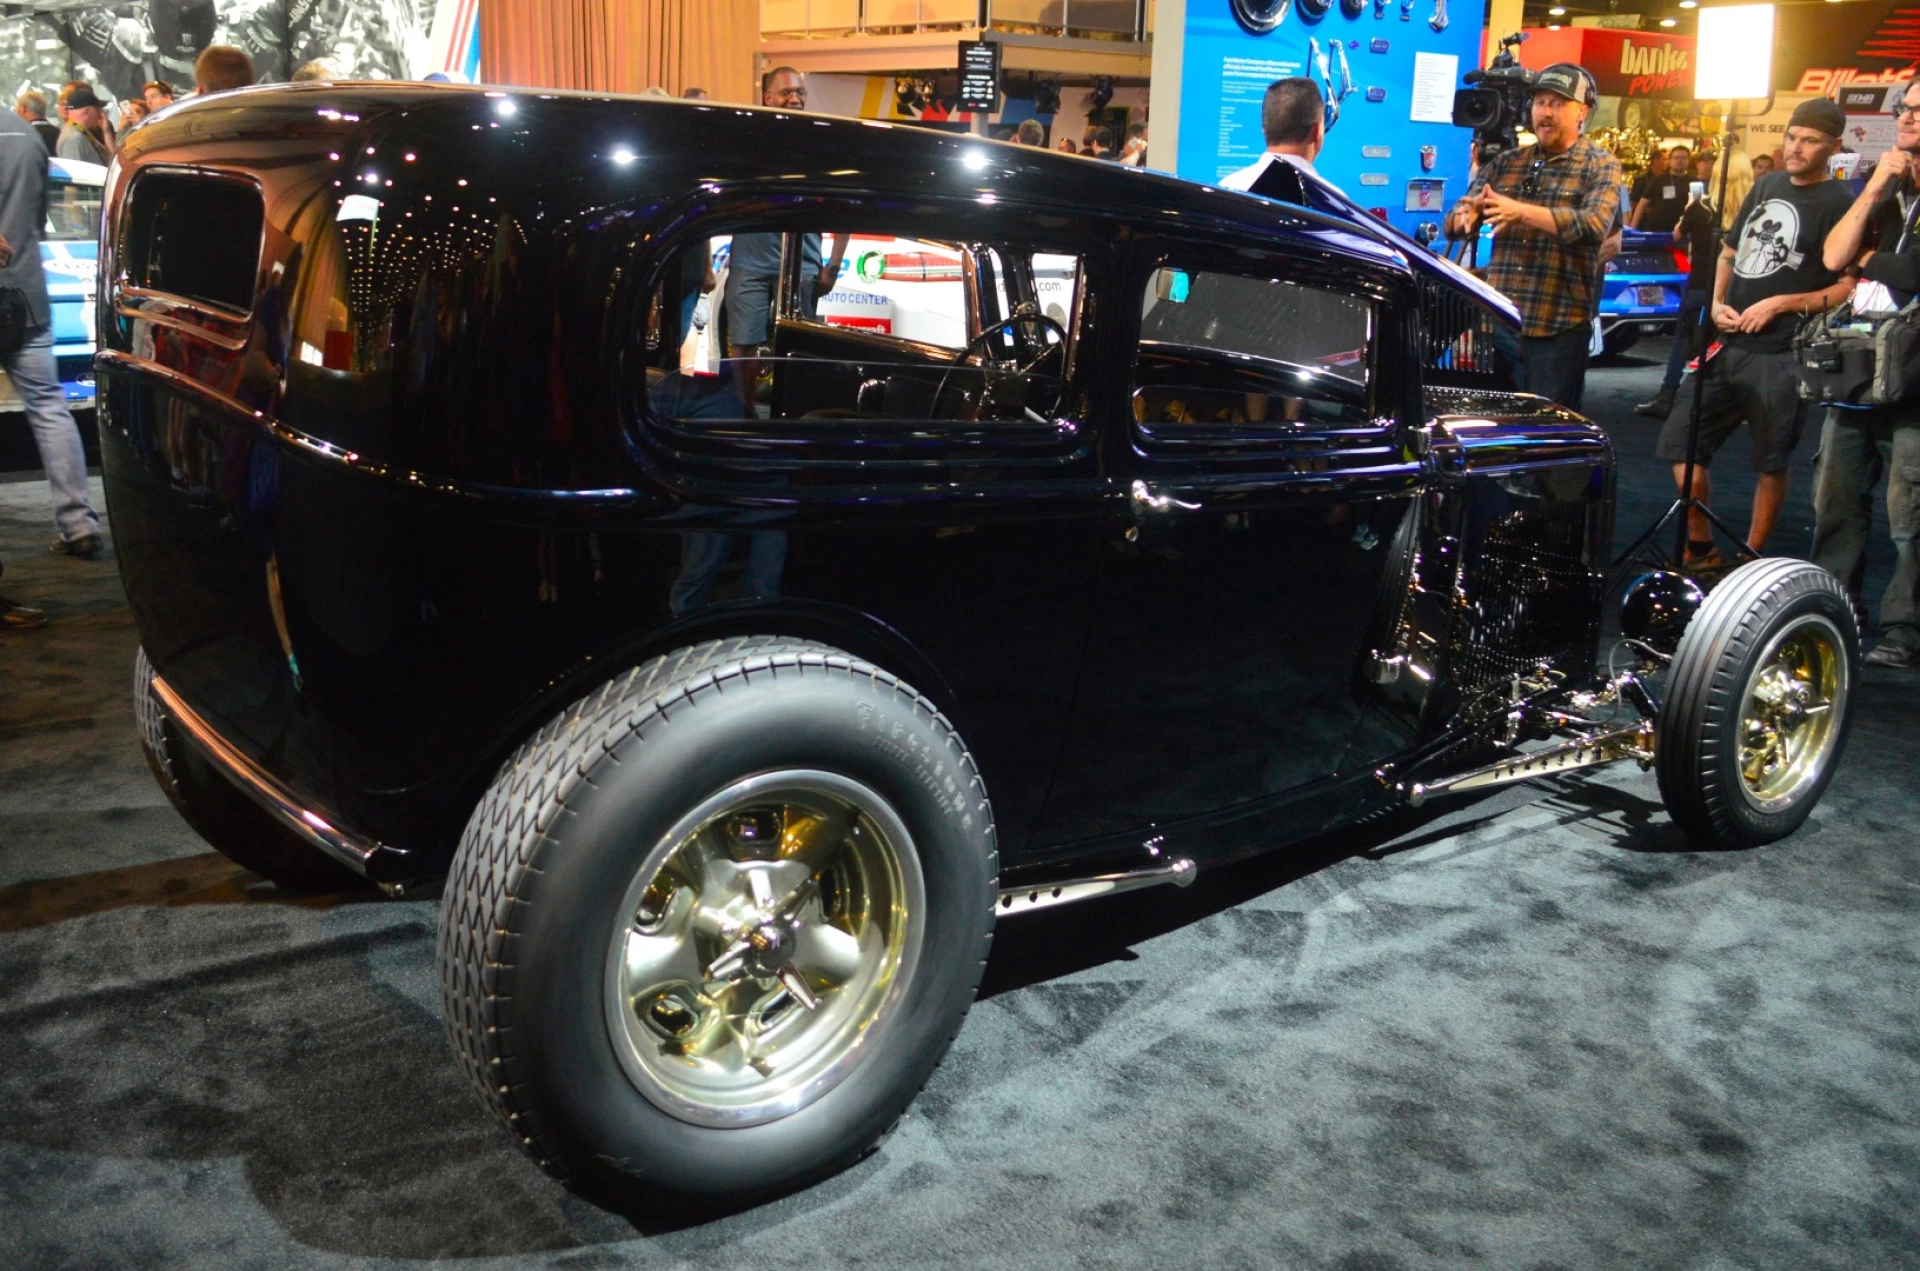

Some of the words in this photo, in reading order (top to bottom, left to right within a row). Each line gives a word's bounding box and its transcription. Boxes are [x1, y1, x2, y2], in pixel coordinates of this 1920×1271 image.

[1750, 124, 1767, 133] WE
[822, 292, 847, 303] AUTO
[848, 293, 889, 306] CENTER
